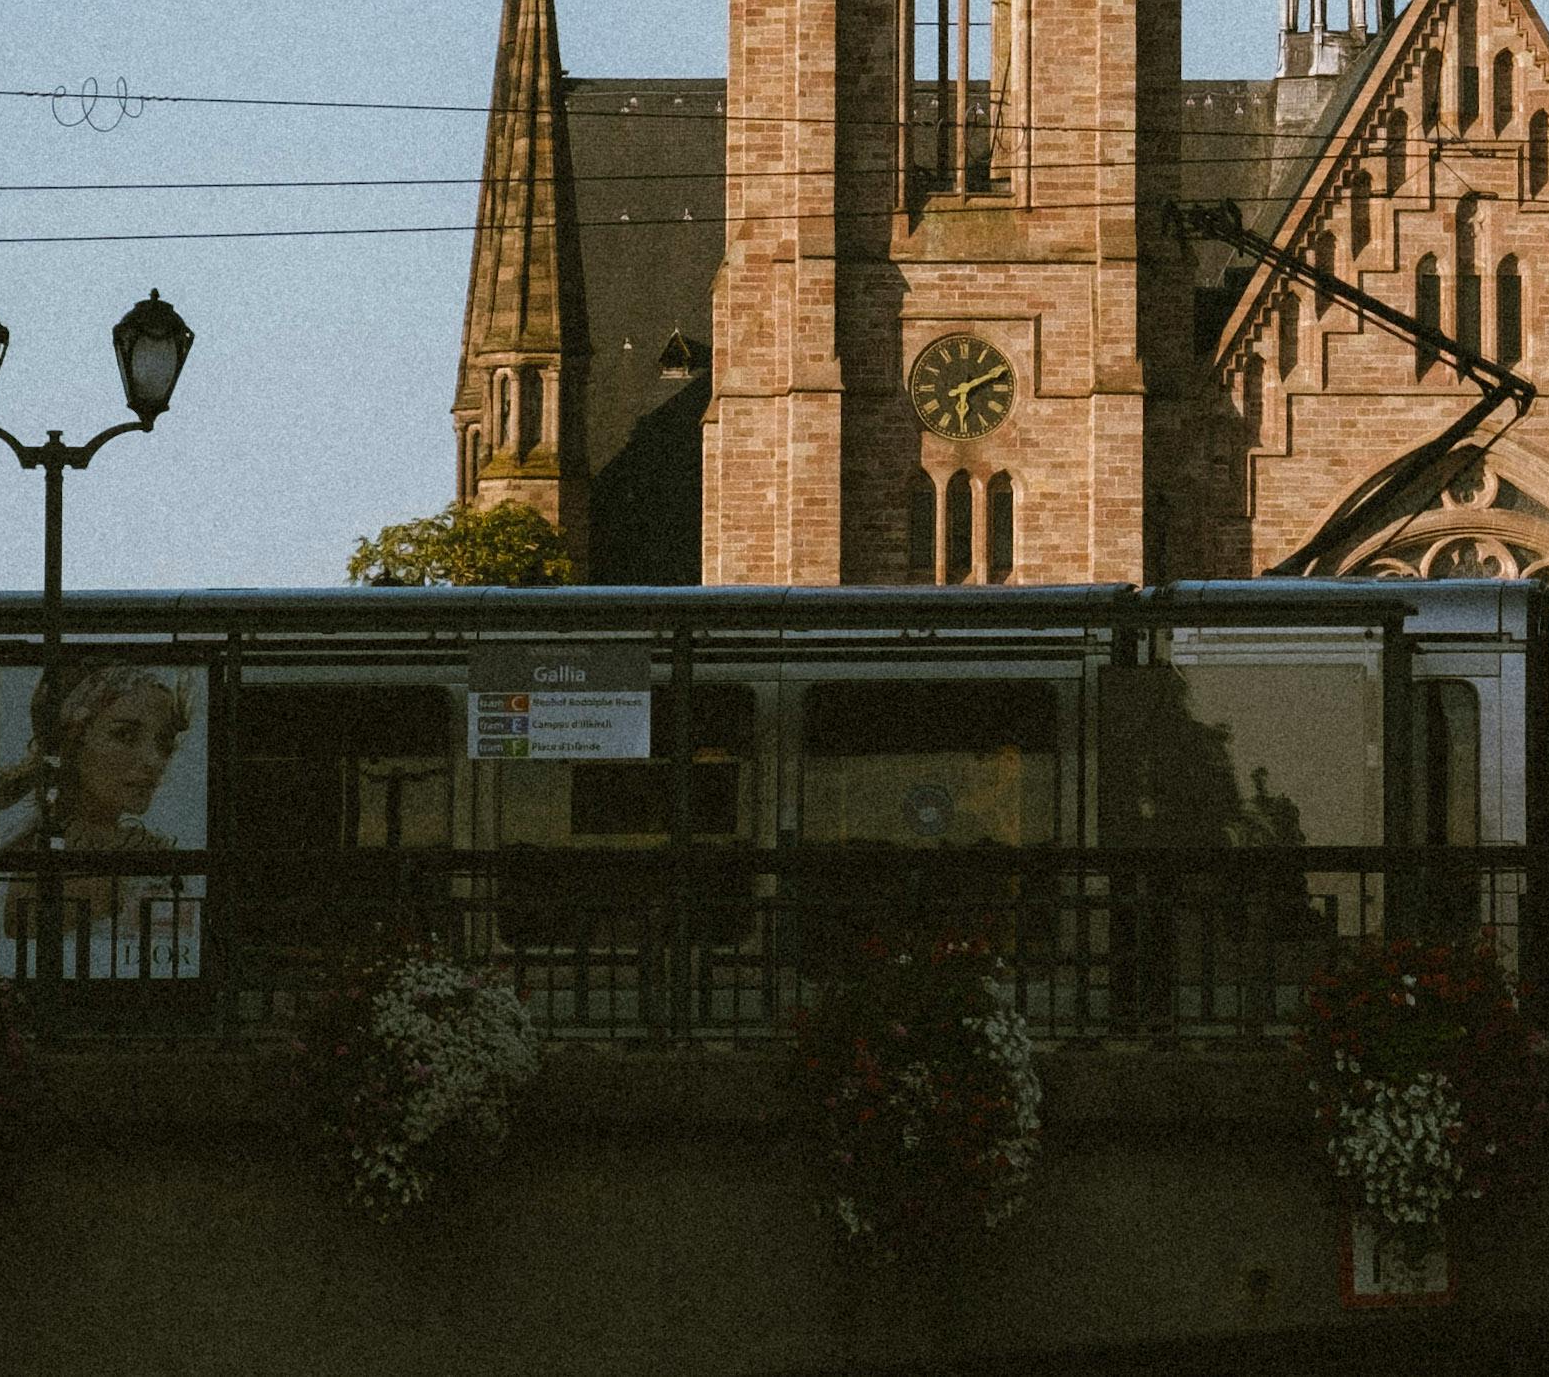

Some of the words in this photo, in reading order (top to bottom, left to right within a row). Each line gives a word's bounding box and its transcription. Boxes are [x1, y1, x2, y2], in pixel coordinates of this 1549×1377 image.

[533, 665, 586, 683] Gallia
[511, 695, 525, 711] C
[511, 717, 523, 734] E
[124, 944, 192, 966] DOR
